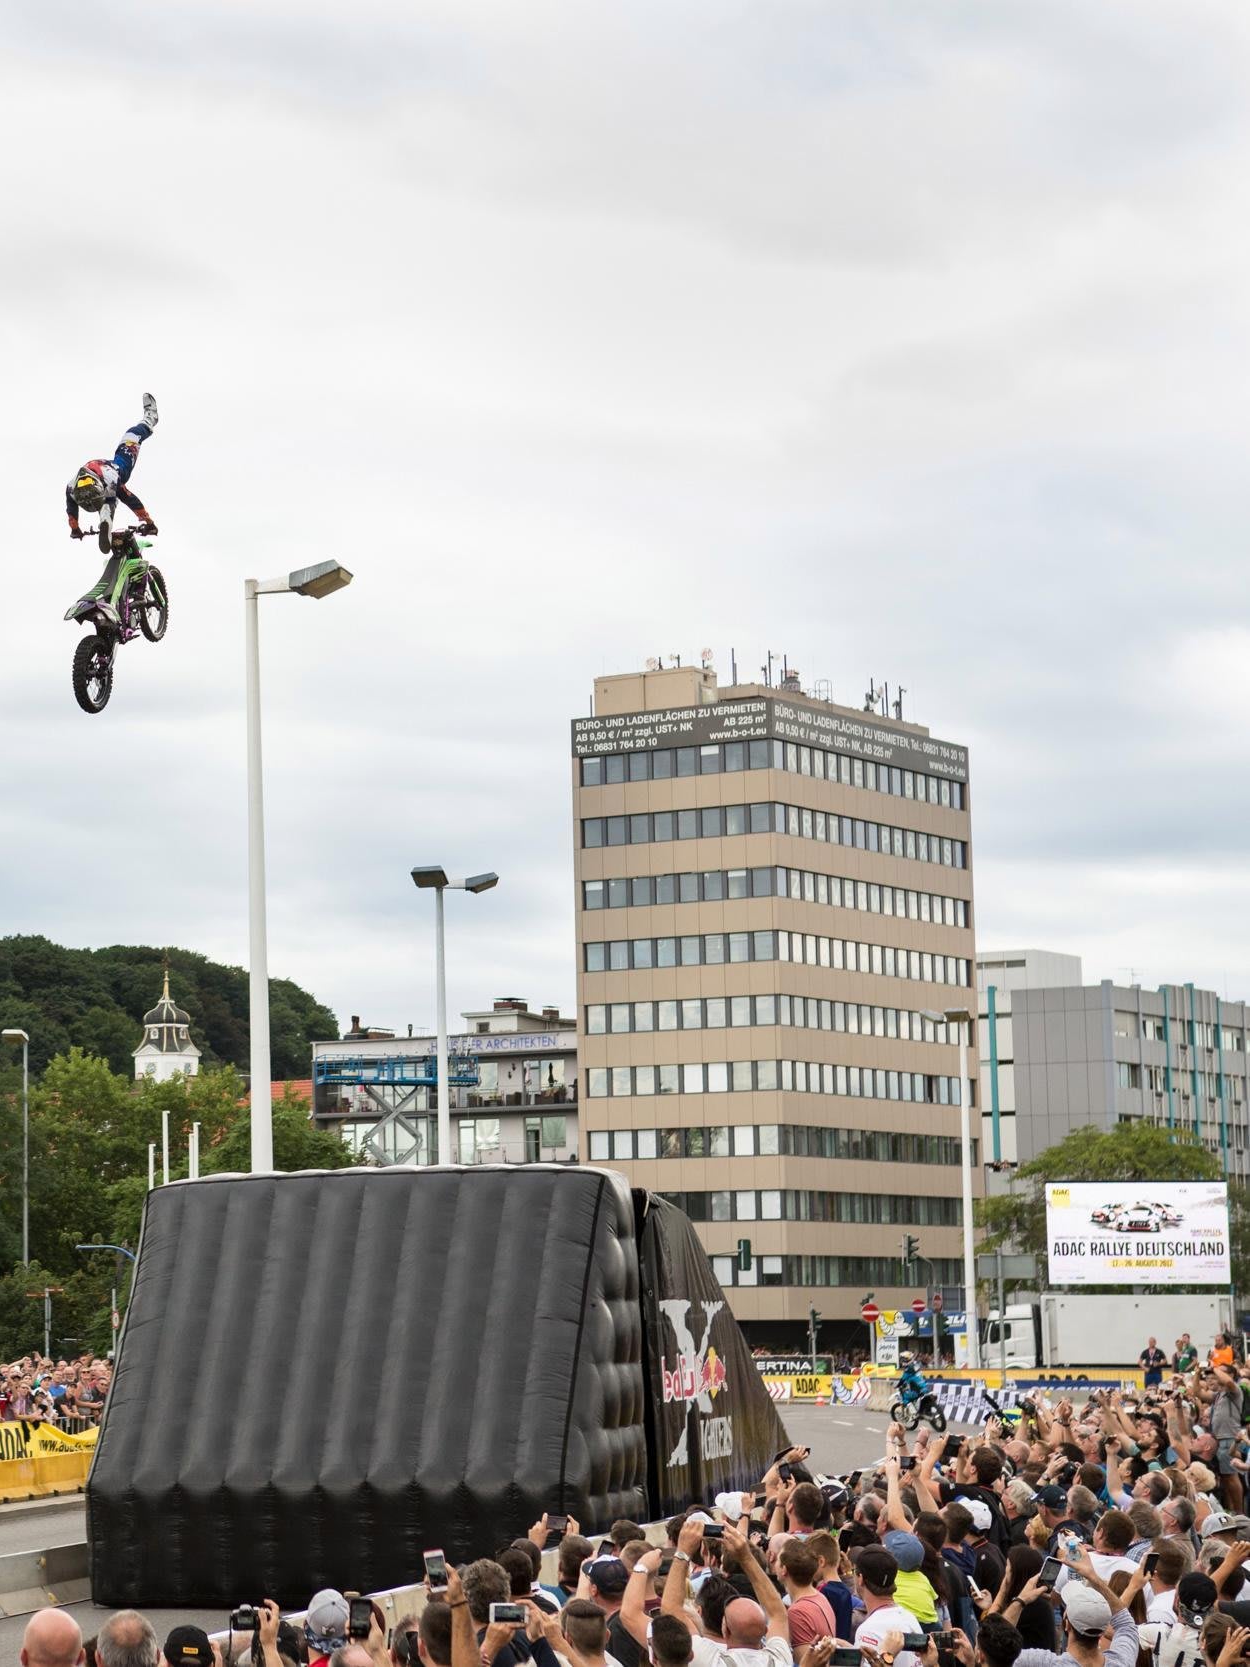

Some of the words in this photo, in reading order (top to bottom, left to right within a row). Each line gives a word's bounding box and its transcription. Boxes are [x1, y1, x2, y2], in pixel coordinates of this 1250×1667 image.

[576, 720, 603, 730] BÜRO-
[606, 718, 624, 727] UND
[627, 710, 696, 725] LADENFLÄCHEN
[698, 708, 710, 717] ZU
[712, 702, 766, 716] VERMIETEN!
[724, 717, 735, 727] AB
[738, 716, 753, 725] 225
[755, 714, 766, 723] m²
[576, 733, 588, 742] AB
[590, 731, 606, 741] 9,50
[622, 728, 632, 737] m²
[635, 727, 653, 737] zzgl.
[680, 722, 693, 731] NK
[710, 727, 766, 740] www.b-o-t.eu
[775, 704, 796, 720] BÜRO-
[798, 711, 812, 724] UND
[814, 715, 863, 736] LADENFLÄCHEN
[865, 727, 872, 739] ZU
[951, 750, 957, 760] 20
[959, 752, 964, 762] 10
[775, 721, 784, 733] AB
[786, 724, 798, 736] 9,50
[864, 743, 872, 754] AB
[873, 744, 884, 758] 225
[576, 745, 591, 754] Tel.:
[594, 742, 616, 752] 06831
[619, 741, 633, 749] 764
[636, 739, 645, 747] 20
[788, 746, 875, 788] KANZLEI
[789, 811, 838, 842] ARZT
[881, 827, 953, 865] PRAXIS
[486, 1036, 556, 1049] ARCHITEKTEN
[1053, 1242, 1086, 1256] ADAC
[1090, 1242, 1132, 1256] RALLYE
[1136, 1242, 1224, 1256] DEUTSCHLAND
[756, 1361, 812, 1371] ERTINA
[796, 1378, 820, 1394] ADAC
